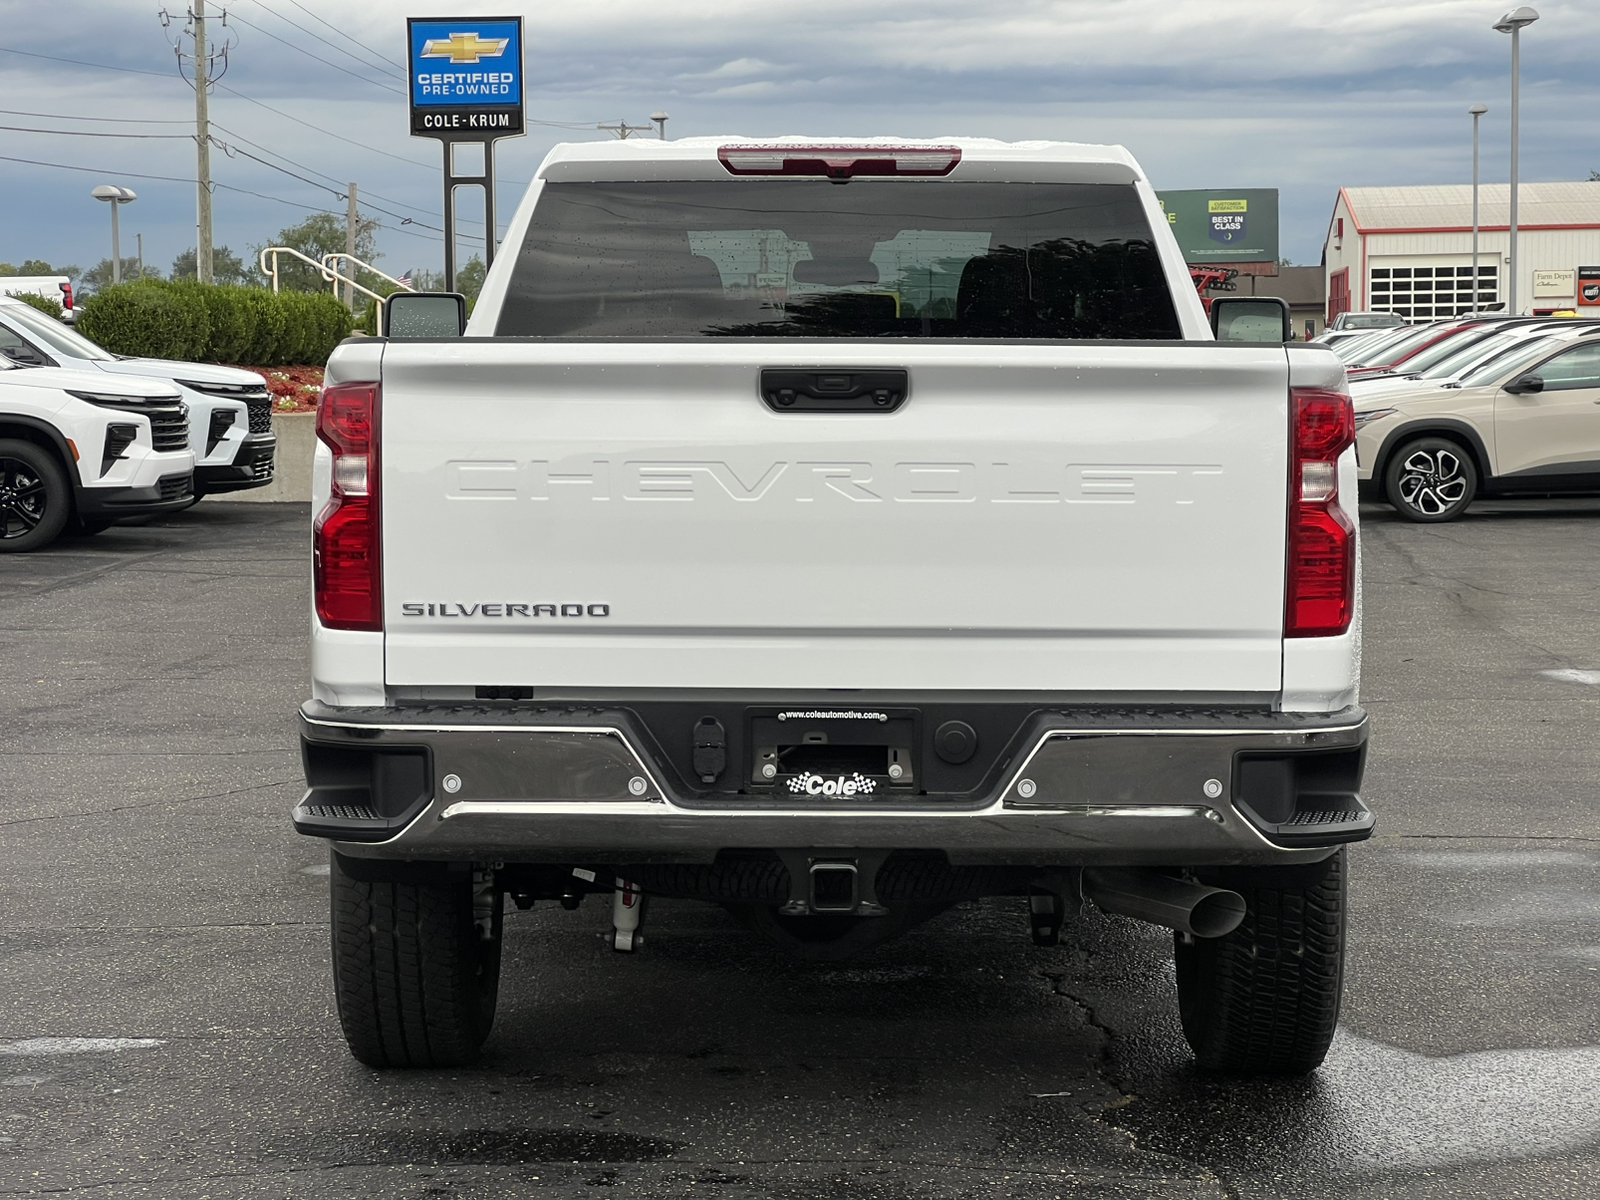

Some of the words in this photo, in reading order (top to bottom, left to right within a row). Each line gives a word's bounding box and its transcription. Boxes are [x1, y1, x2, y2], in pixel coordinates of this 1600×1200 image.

[418, 73, 513, 84] CERTIFIED
[422, 84, 509, 95] PRE-OWNED
[424, 114, 509, 128] COLE-KRUM
[1214, 222, 1241, 230] CLASS
[445, 459, 1223, 503] CHEVROLET
[402, 602, 610, 617] SILVERADO
[785, 710, 880, 720] www.coleautomotive.com
[805, 775, 857, 795] Cole
